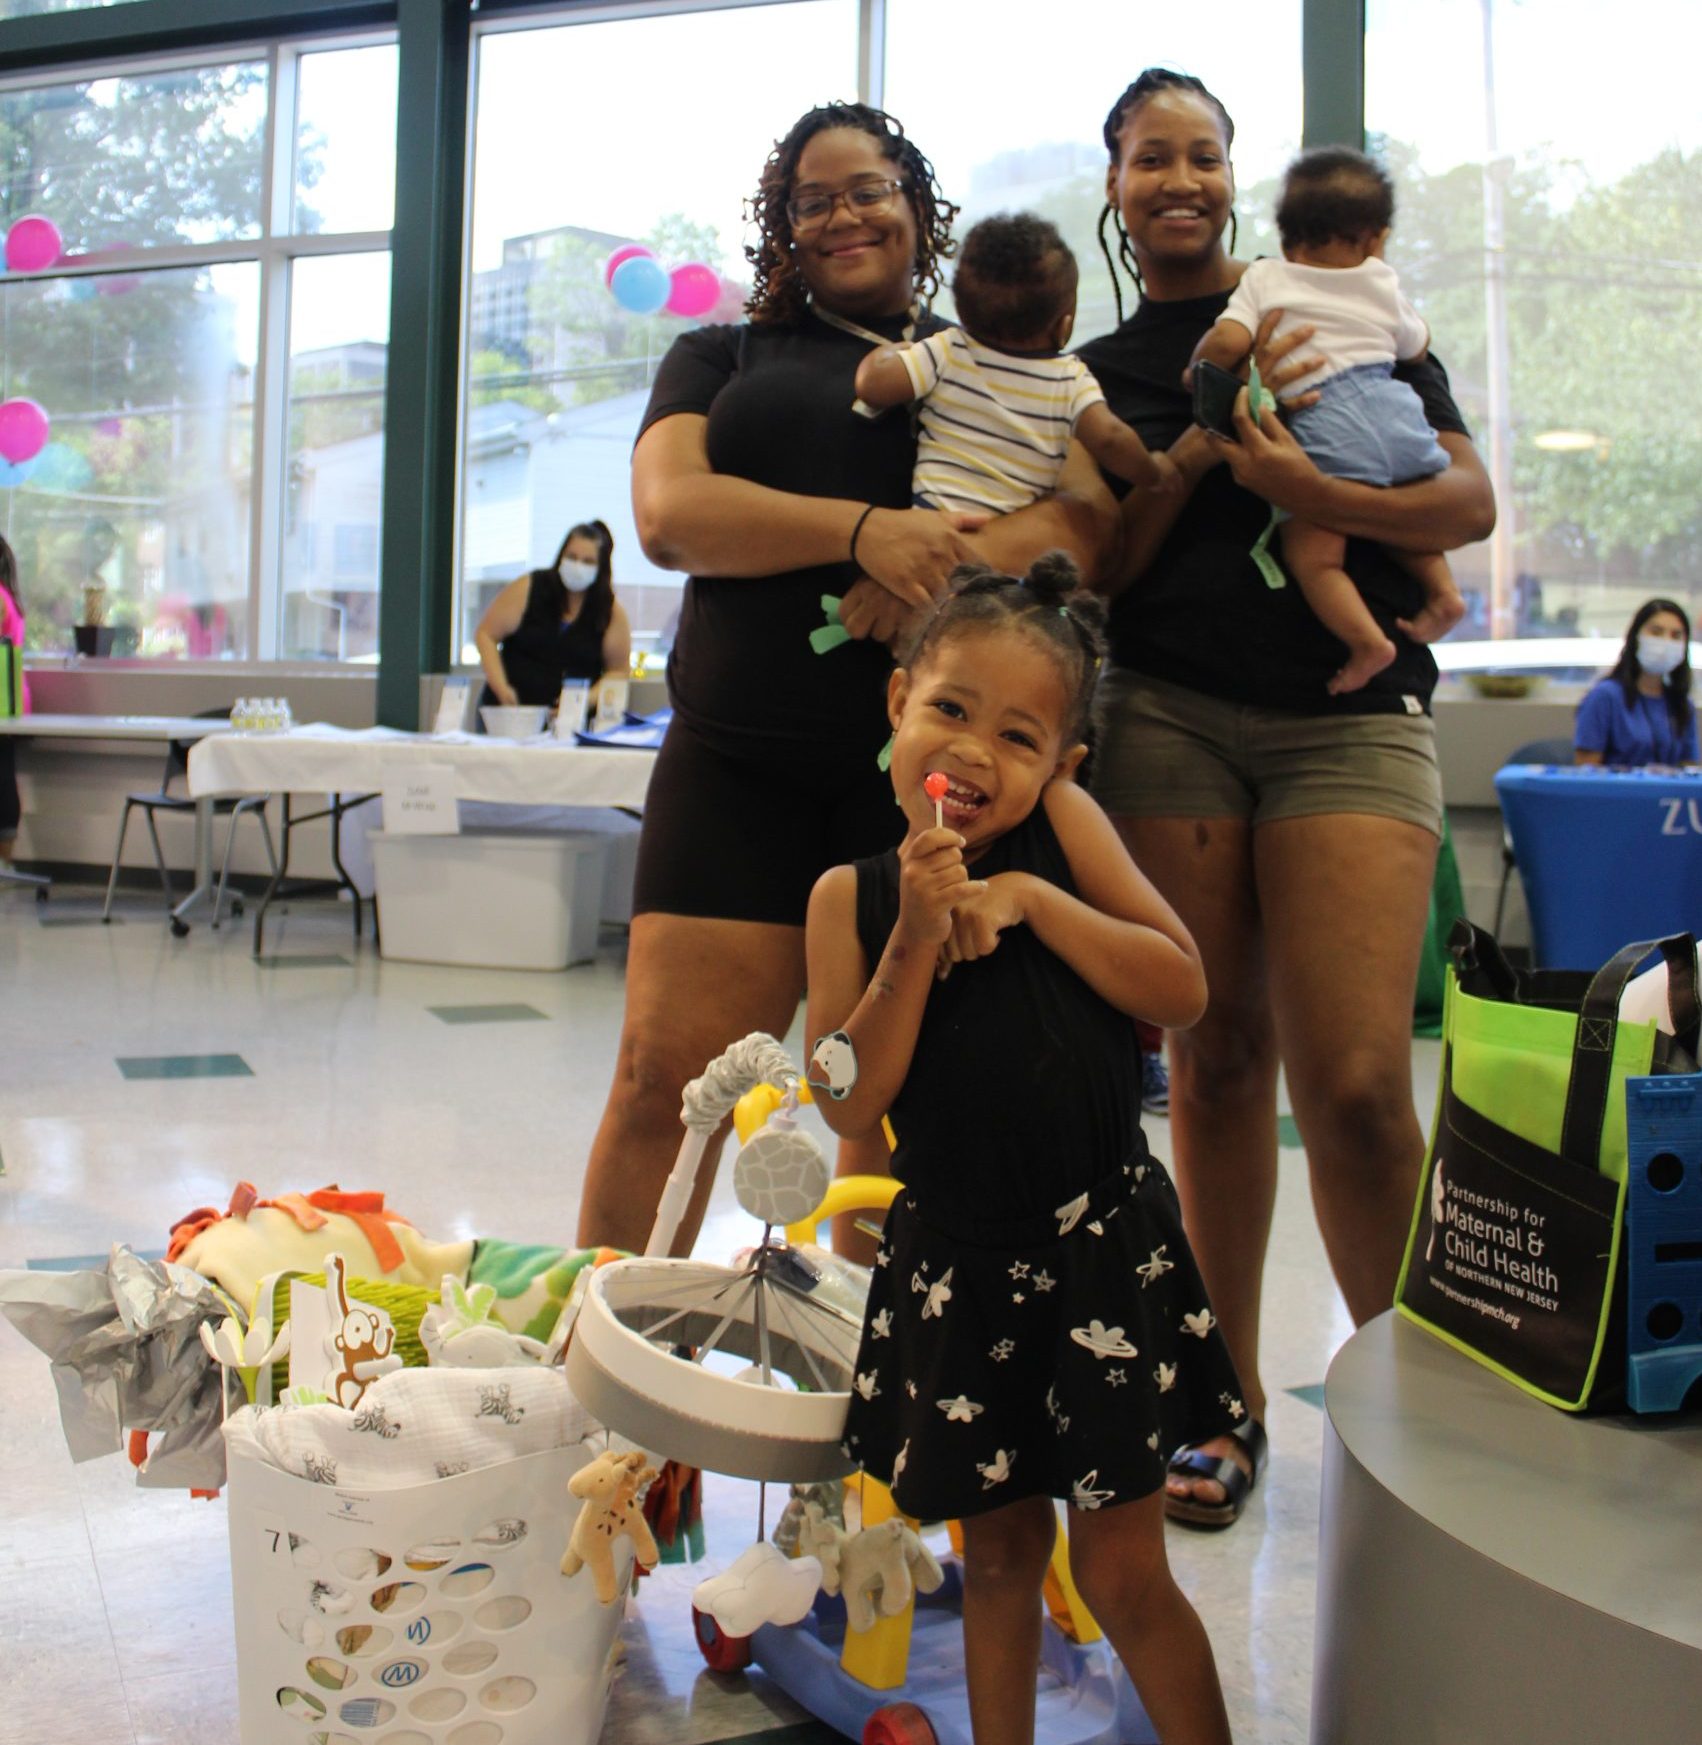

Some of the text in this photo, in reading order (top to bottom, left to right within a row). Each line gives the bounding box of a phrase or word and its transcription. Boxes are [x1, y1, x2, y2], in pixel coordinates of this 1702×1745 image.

[1445, 1201, 1545, 1257] Maternal &
[1446, 1179, 1545, 1228] Partnership for
[1444, 1259, 1560, 1312] OF NORTHERN NEW JERSEY
[1445, 1230, 1560, 1293] Child Health
[265, 1529, 280, 1552] 7
